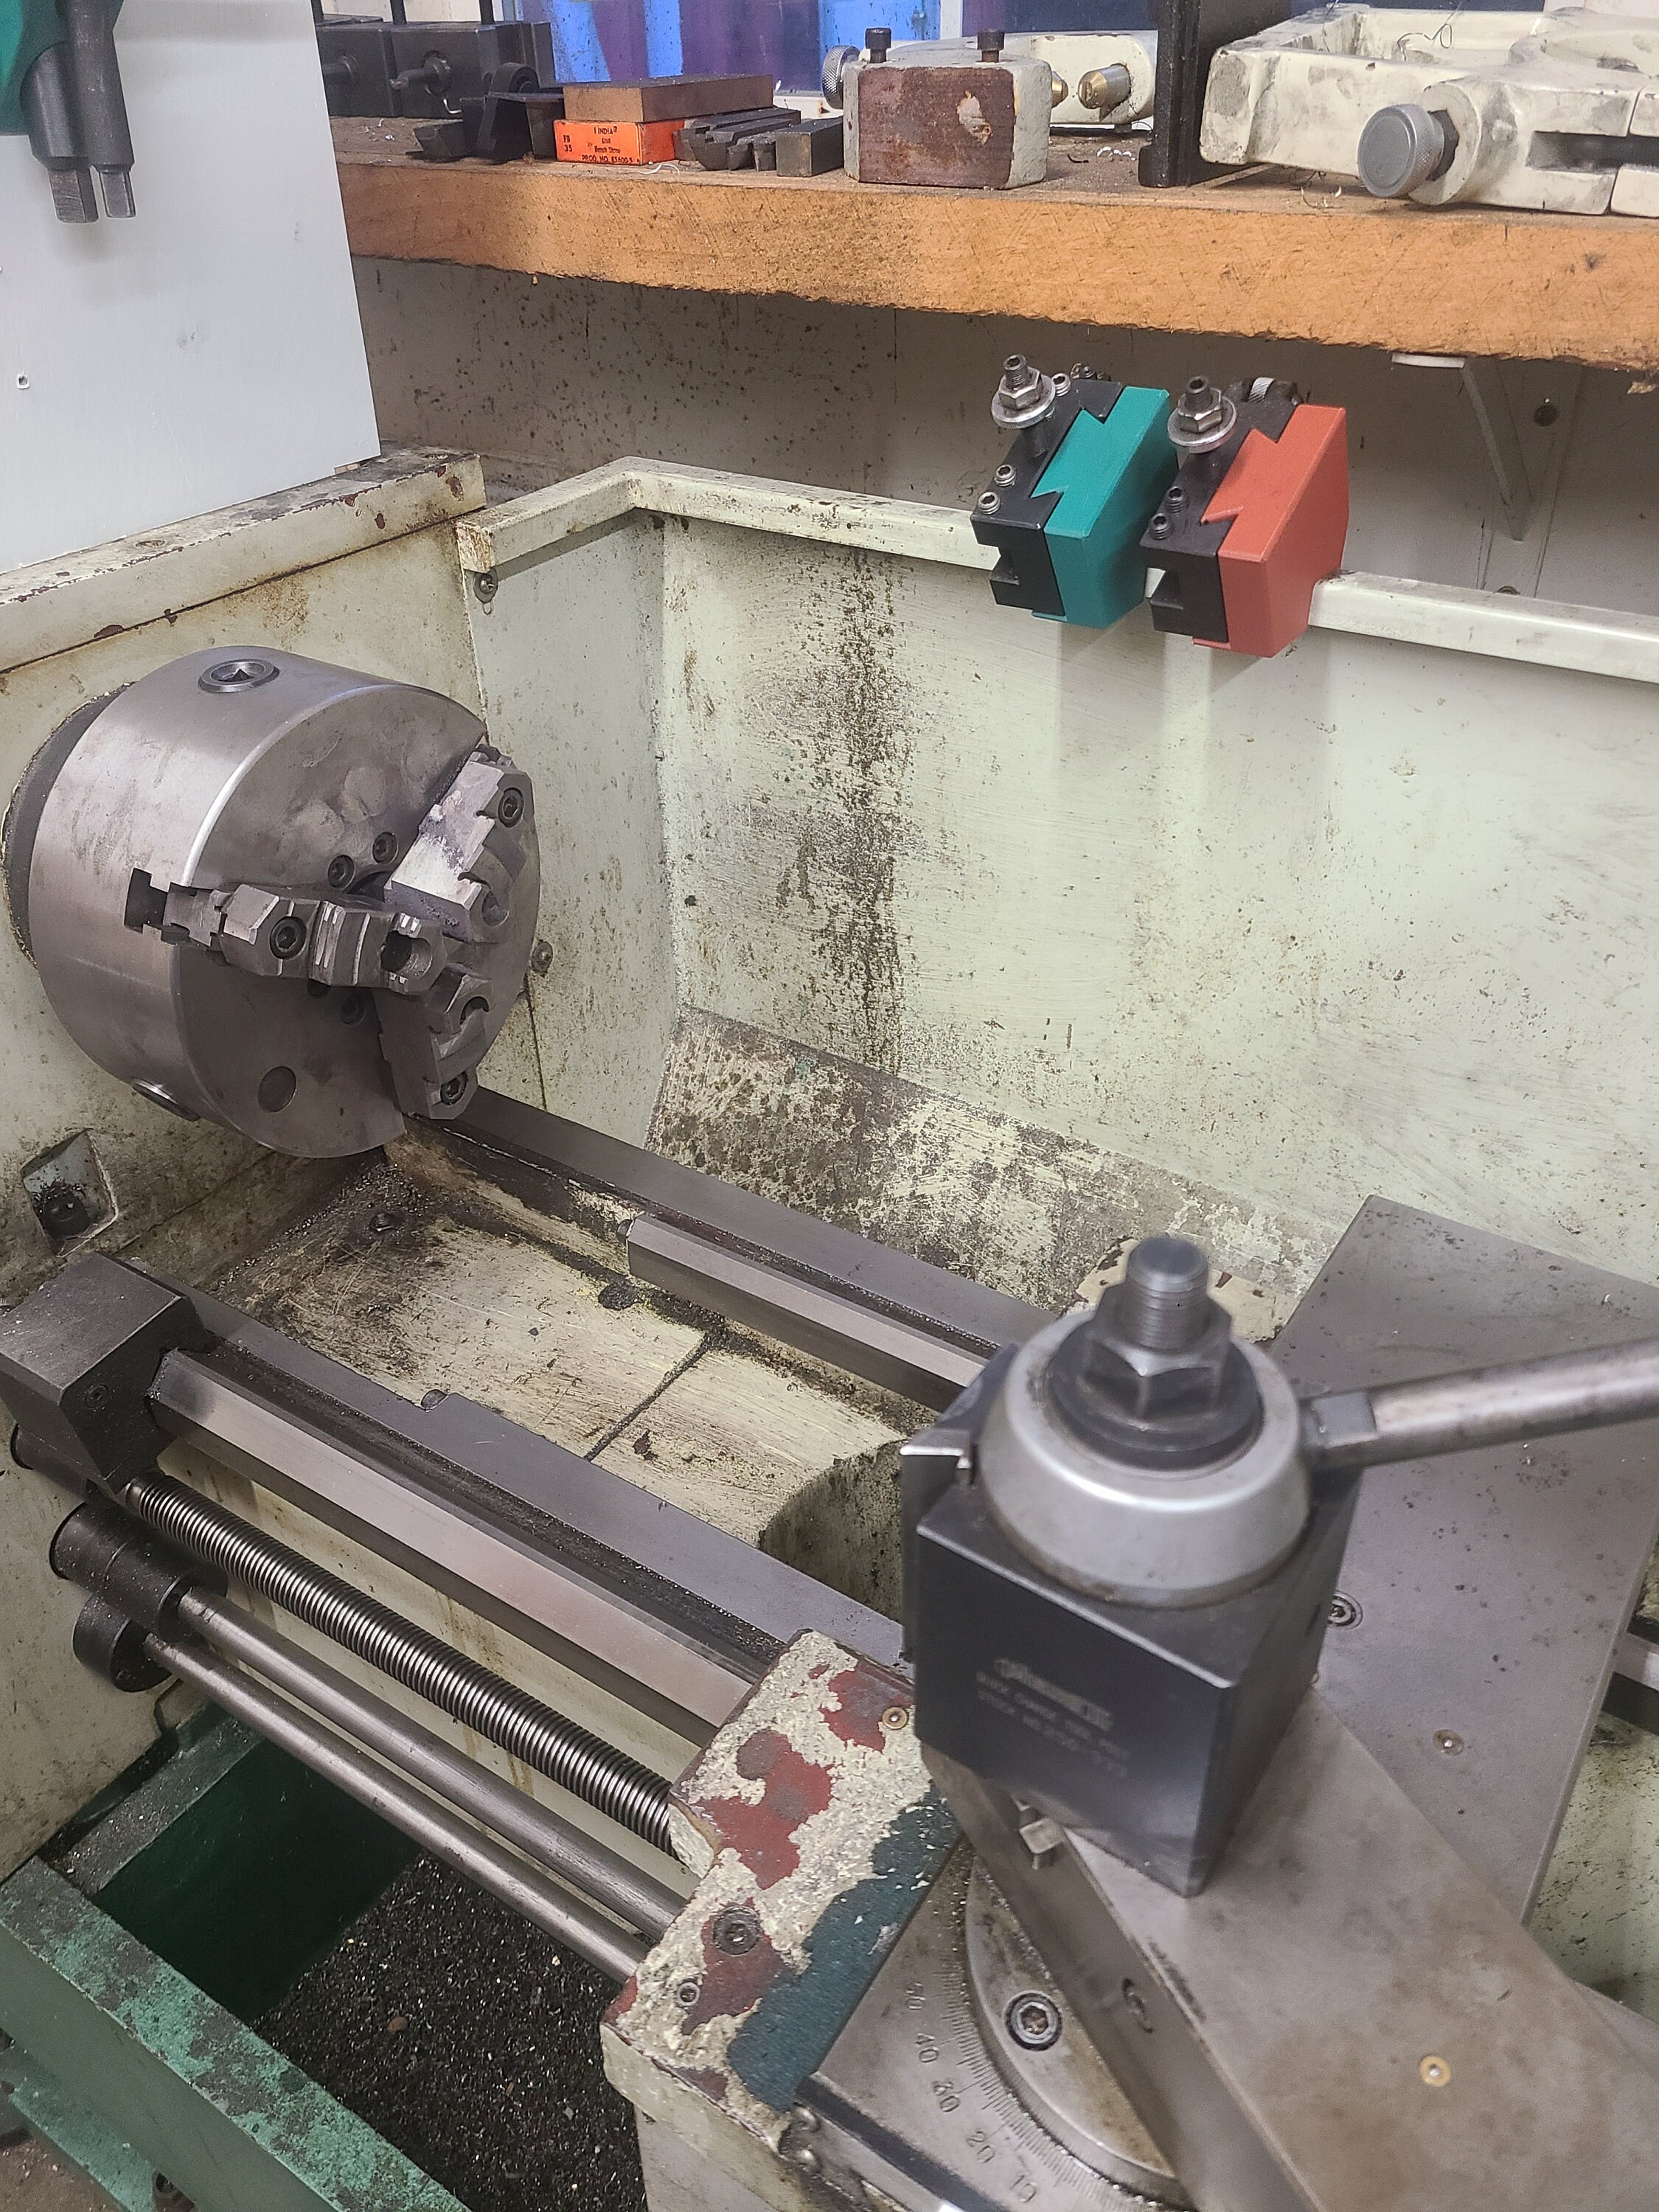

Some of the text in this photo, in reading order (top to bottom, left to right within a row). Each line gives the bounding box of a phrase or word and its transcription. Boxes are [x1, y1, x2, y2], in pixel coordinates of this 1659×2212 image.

[563, 135, 571, 143] FB
[914, 2032, 939, 2063] 40
[966, 2129, 996, 2163] 20
